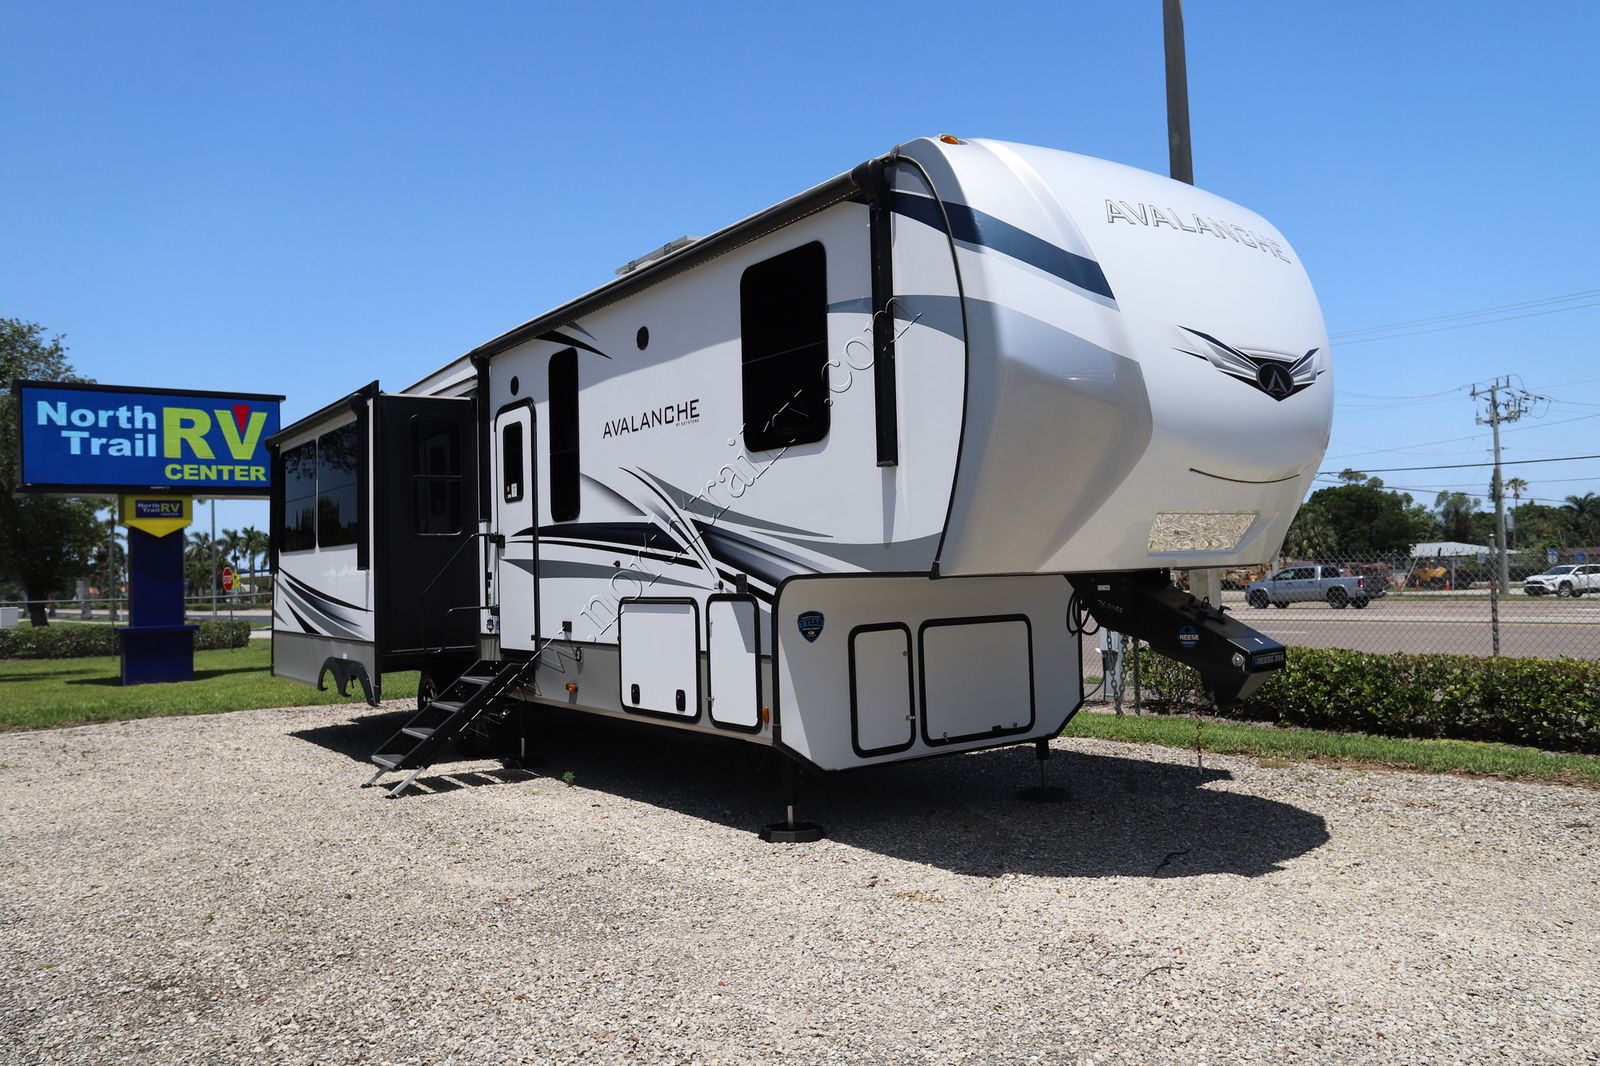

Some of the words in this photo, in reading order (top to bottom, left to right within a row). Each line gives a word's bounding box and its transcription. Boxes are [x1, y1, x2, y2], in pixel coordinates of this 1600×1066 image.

[1105, 199, 1292, 264] AVALANCHE
[36, 400, 156, 430] North
[602, 398, 700, 439] AVALANCHE
[60, 429, 156, 457] Trail
[162, 406, 268, 460] RV
[164, 463, 267, 482] CENTER
[160, 503, 179, 512] RV
